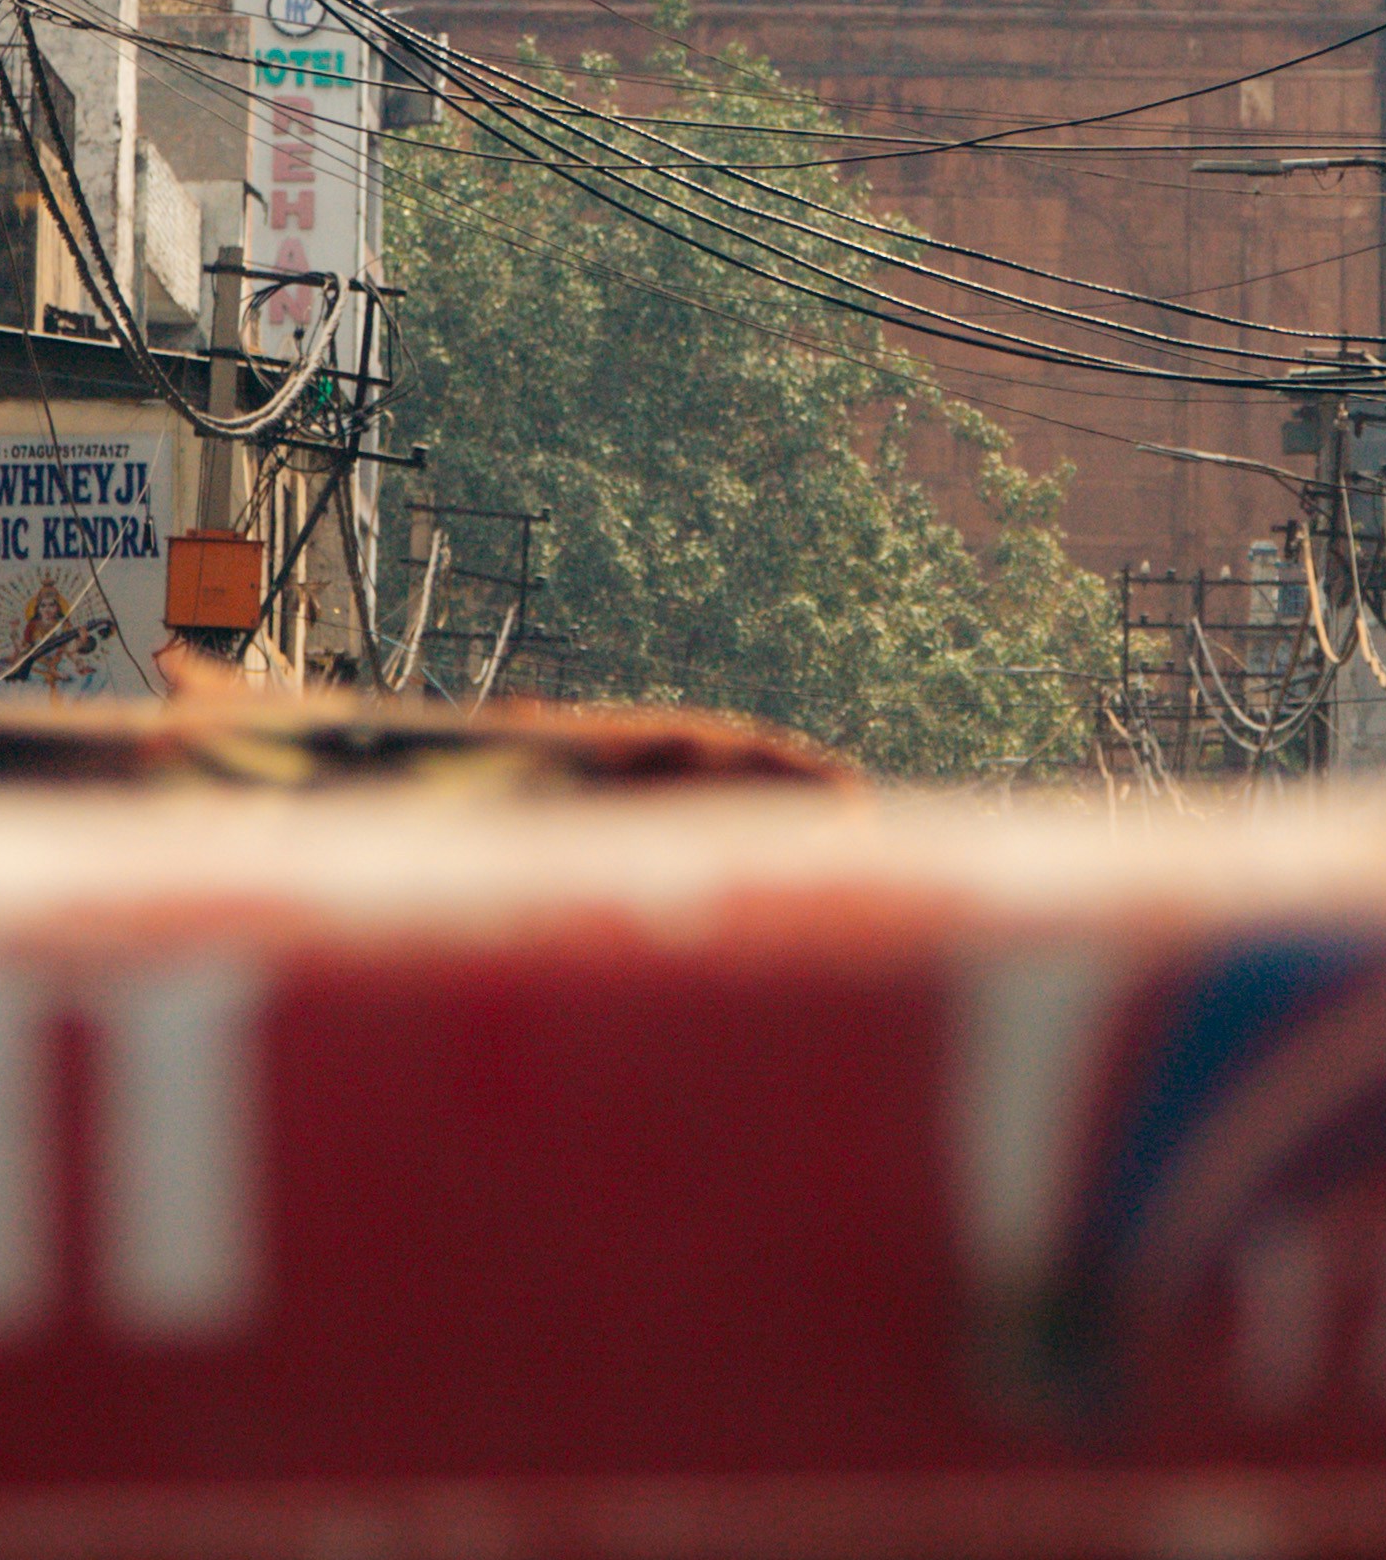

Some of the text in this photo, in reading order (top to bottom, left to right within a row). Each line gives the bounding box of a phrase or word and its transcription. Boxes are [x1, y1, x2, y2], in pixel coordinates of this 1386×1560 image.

[255, 48, 354, 88] OTEL
[268, 95, 316, 325] REHAN
[43, 514, 160, 560] KENDRA
